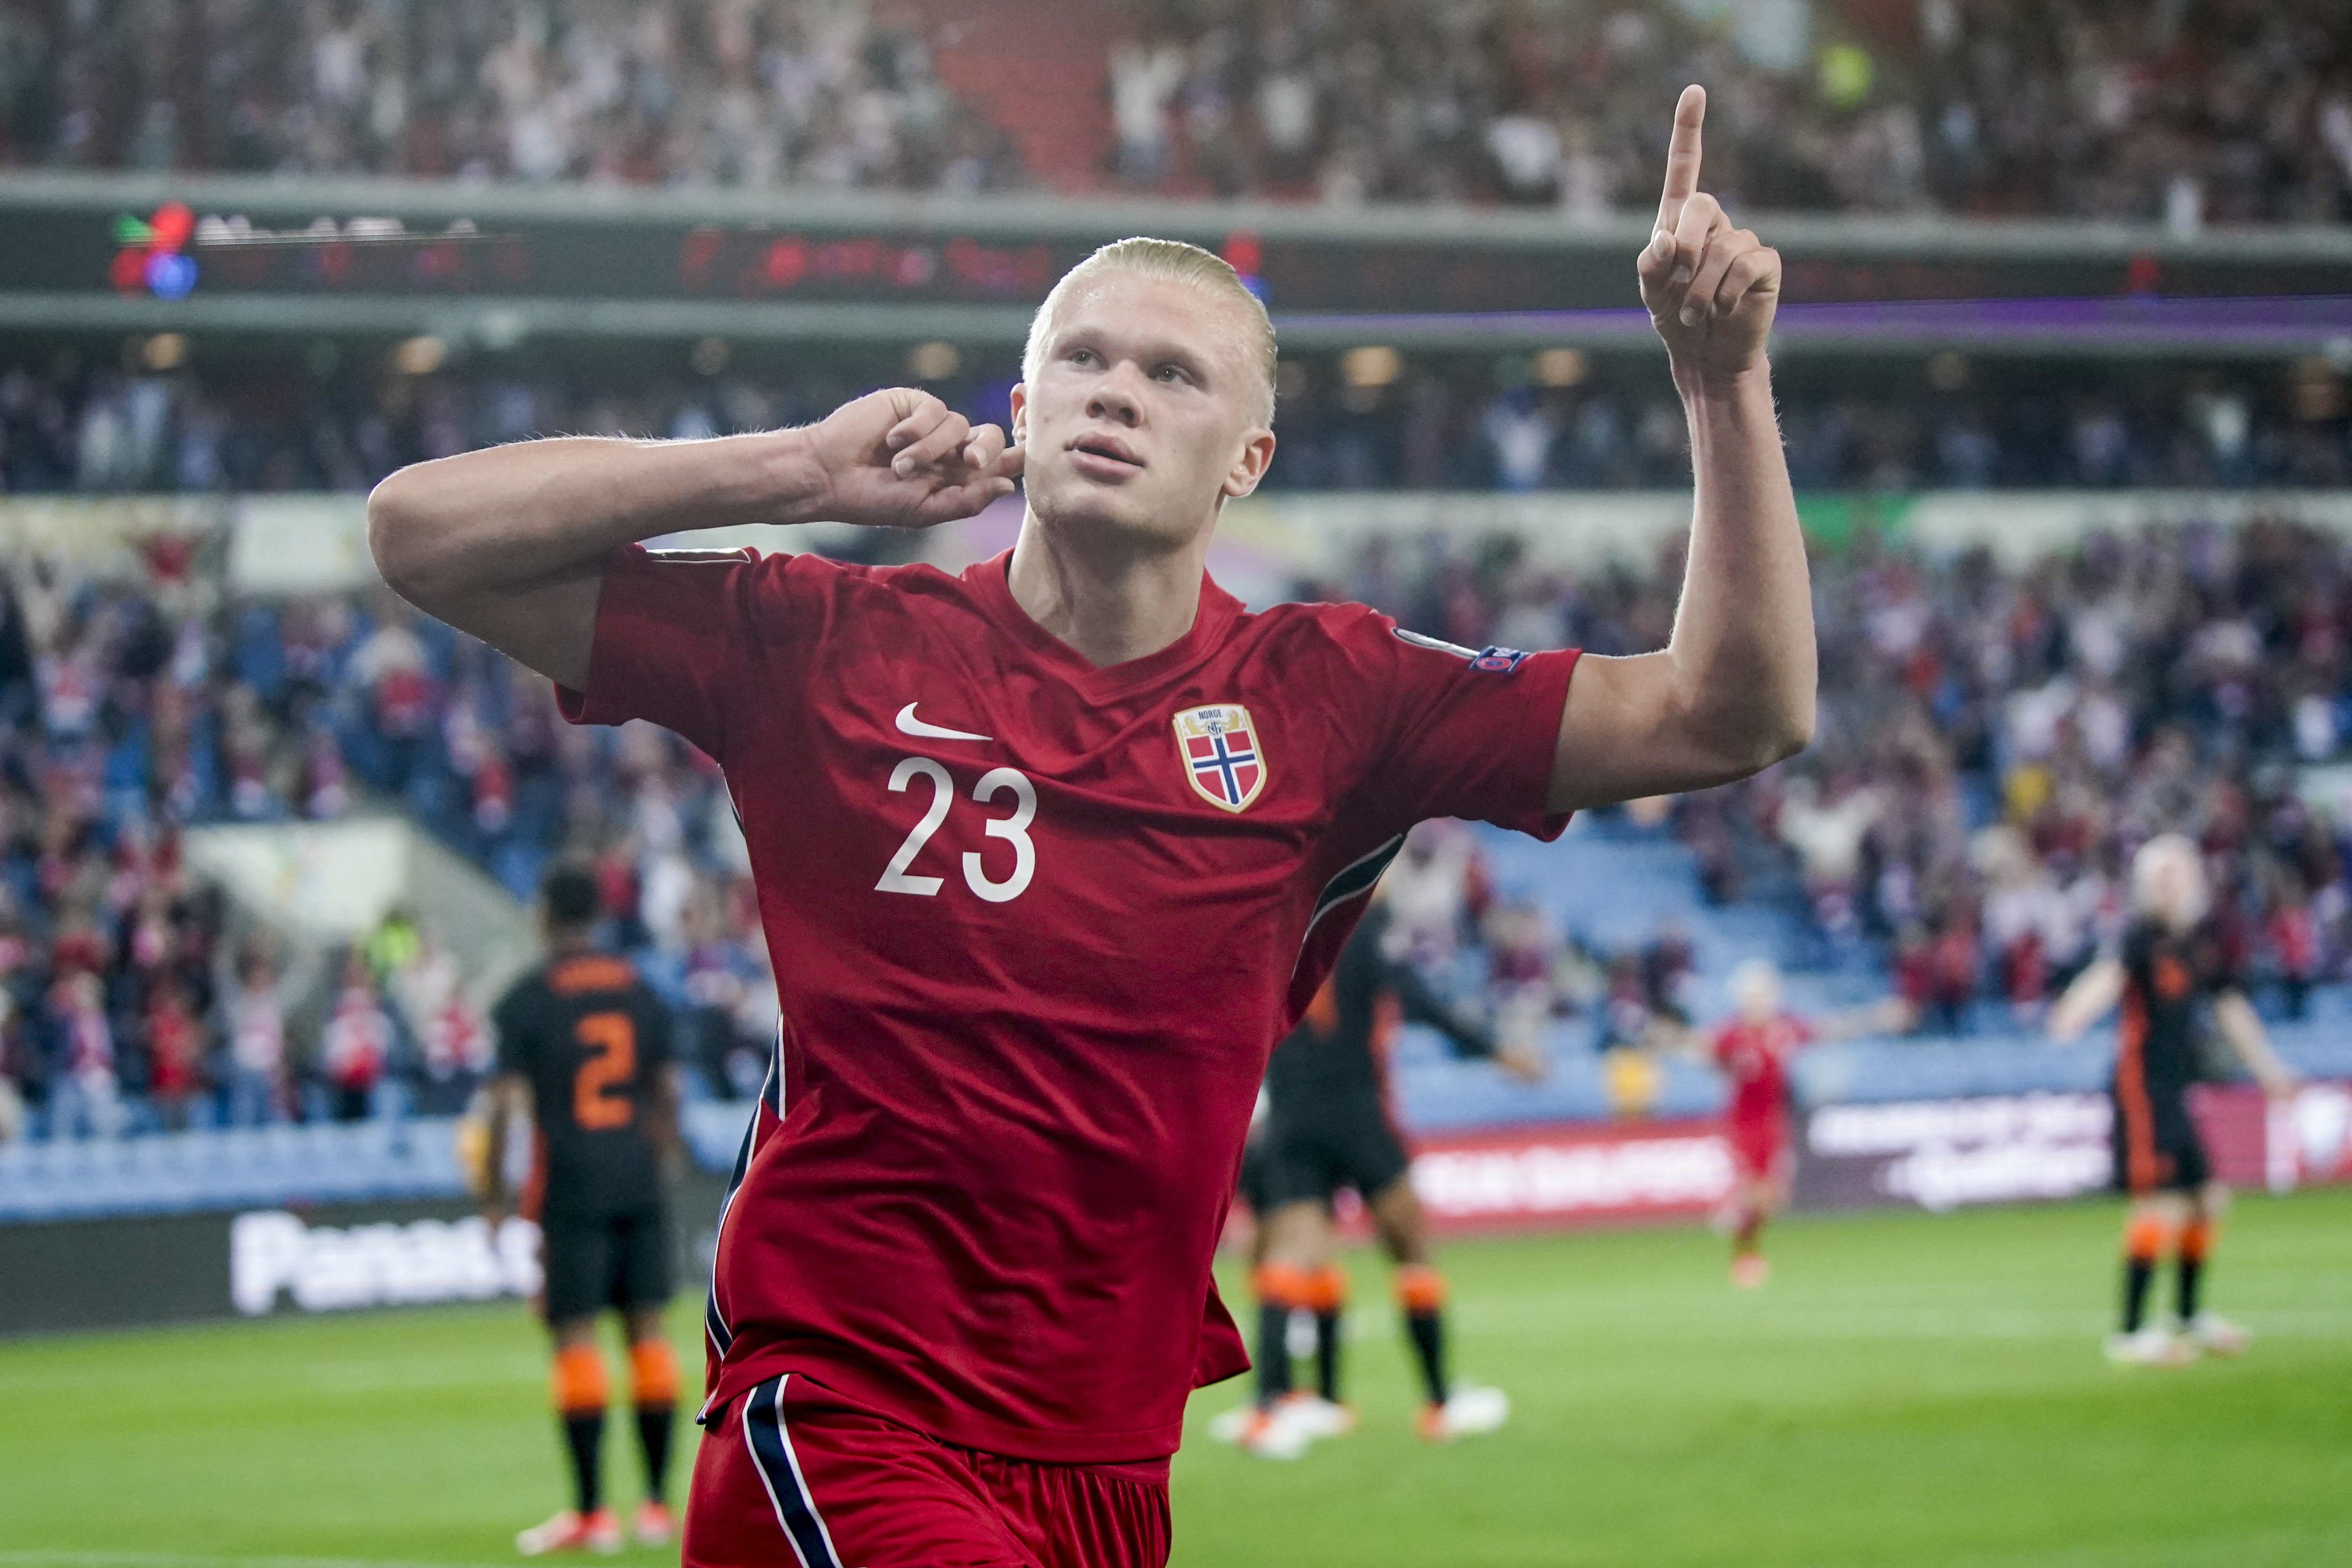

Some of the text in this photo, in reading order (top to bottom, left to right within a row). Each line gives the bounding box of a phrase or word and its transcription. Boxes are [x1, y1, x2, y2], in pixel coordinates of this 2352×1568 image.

[1198, 709, 1223, 720] NORGE
[874, 756, 1037, 903] 23
[573, 1009, 636, 1129] 2
